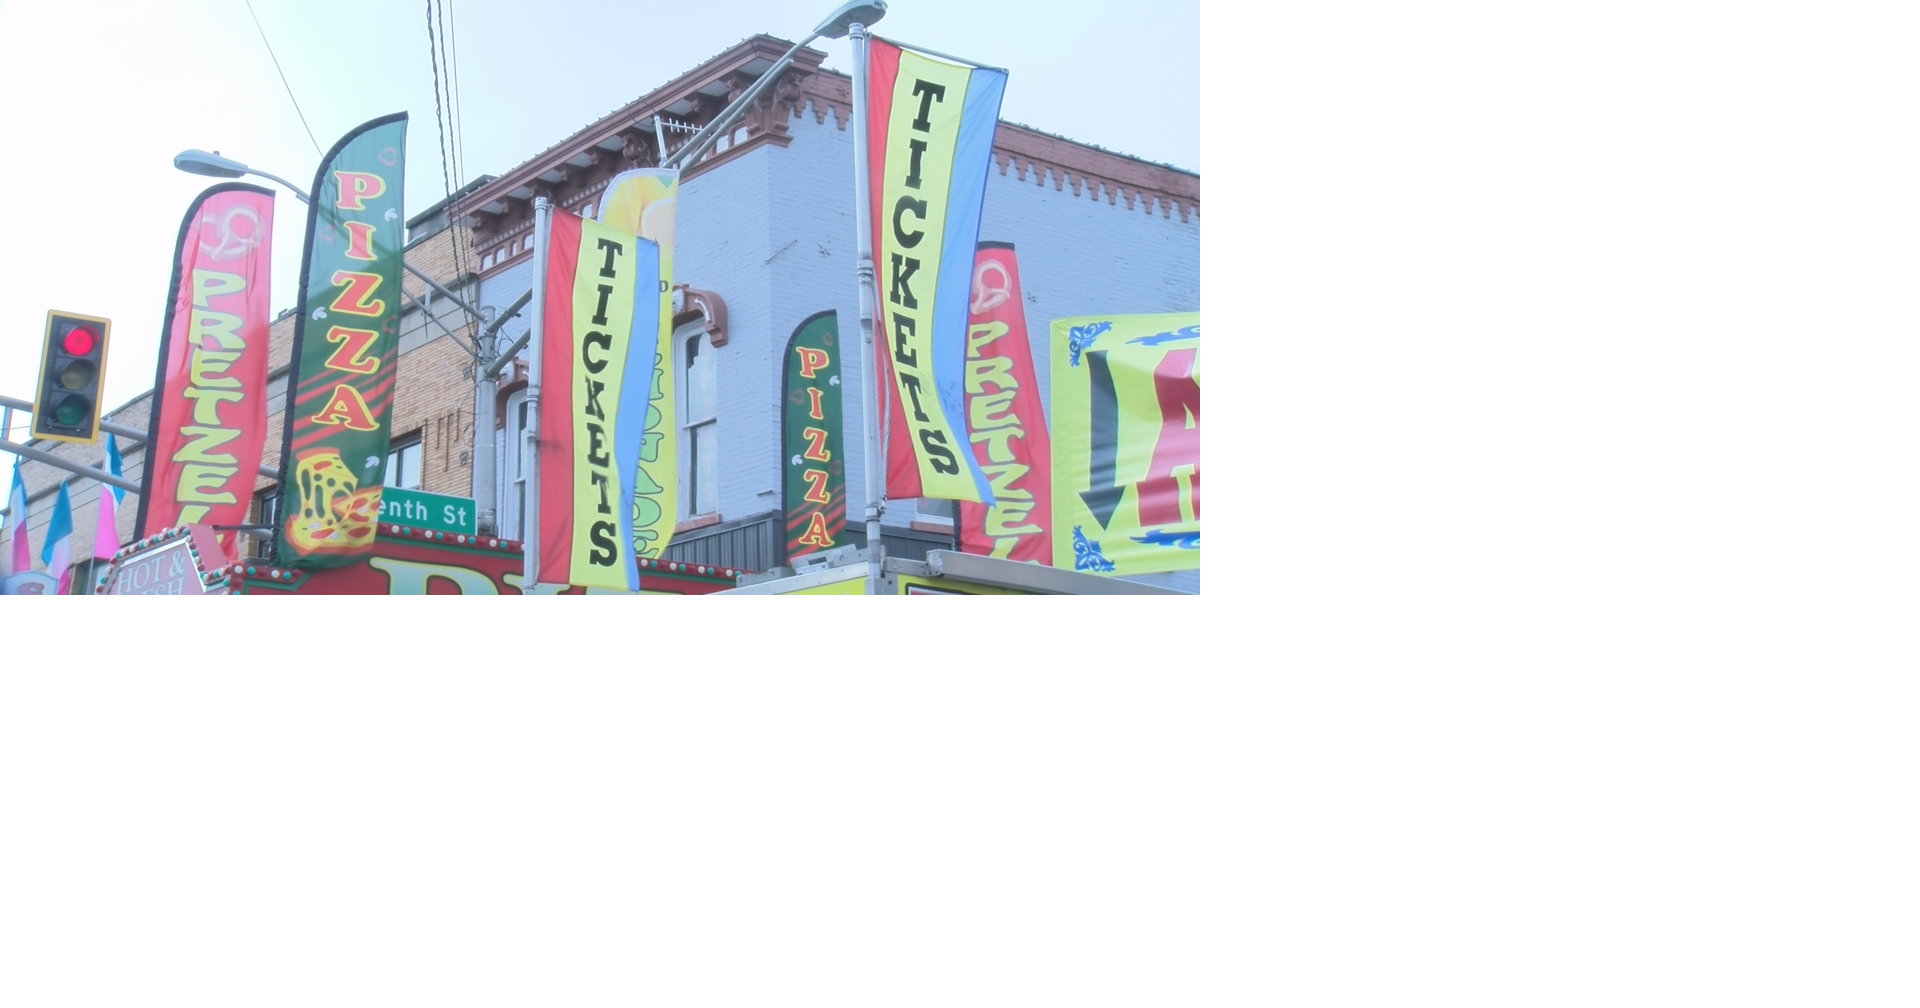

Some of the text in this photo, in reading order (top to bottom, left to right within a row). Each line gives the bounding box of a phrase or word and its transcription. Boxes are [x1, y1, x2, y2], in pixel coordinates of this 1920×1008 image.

[312, 170, 386, 431] PIZZA
[888, 78, 960, 477] TICKETS
[443, 504, 467, 527] St
[582, 237, 623, 567] TICKETS
[796, 346, 834, 547] PIZZA
[116, 554, 166, 594] HOT
[169, 549, 187, 578] &
